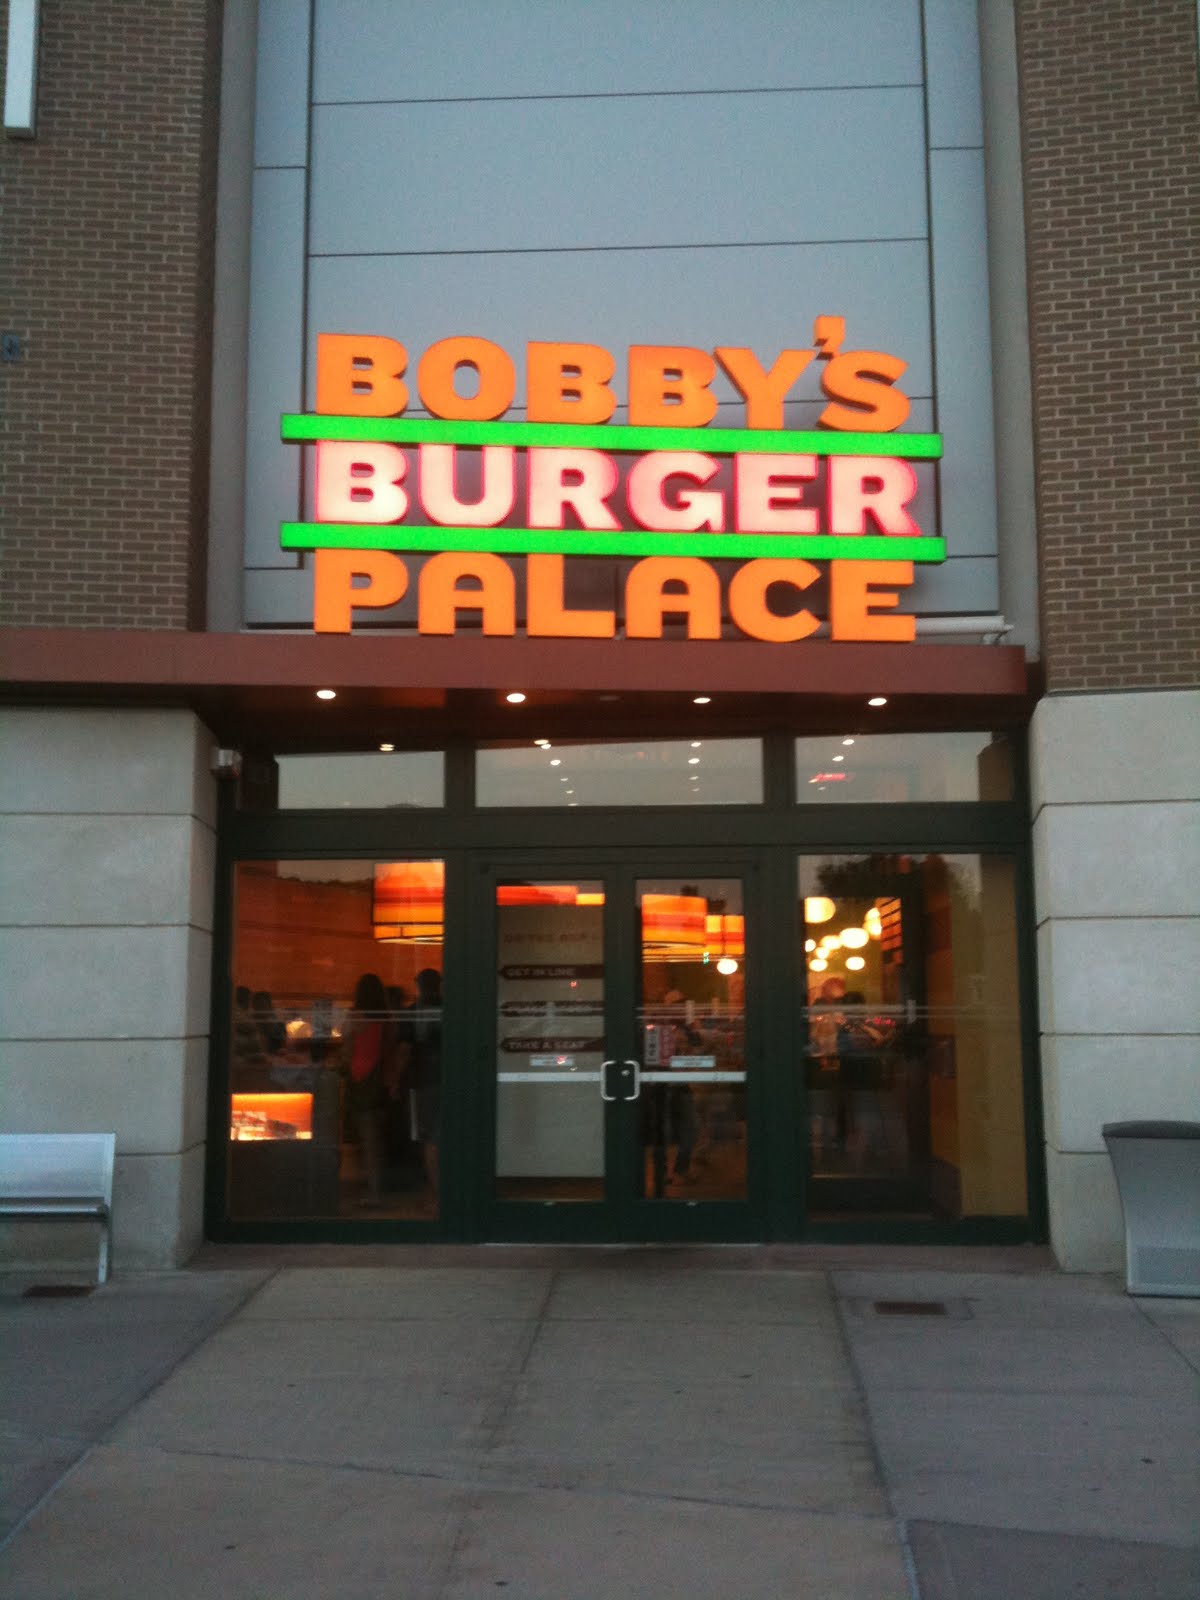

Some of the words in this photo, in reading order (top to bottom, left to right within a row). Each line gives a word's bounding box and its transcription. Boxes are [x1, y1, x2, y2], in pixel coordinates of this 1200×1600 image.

[316, 315, 911, 433] BOBBY'S
[315, 440, 921, 537] BURGER
[313, 549, 916, 644] PALACE
